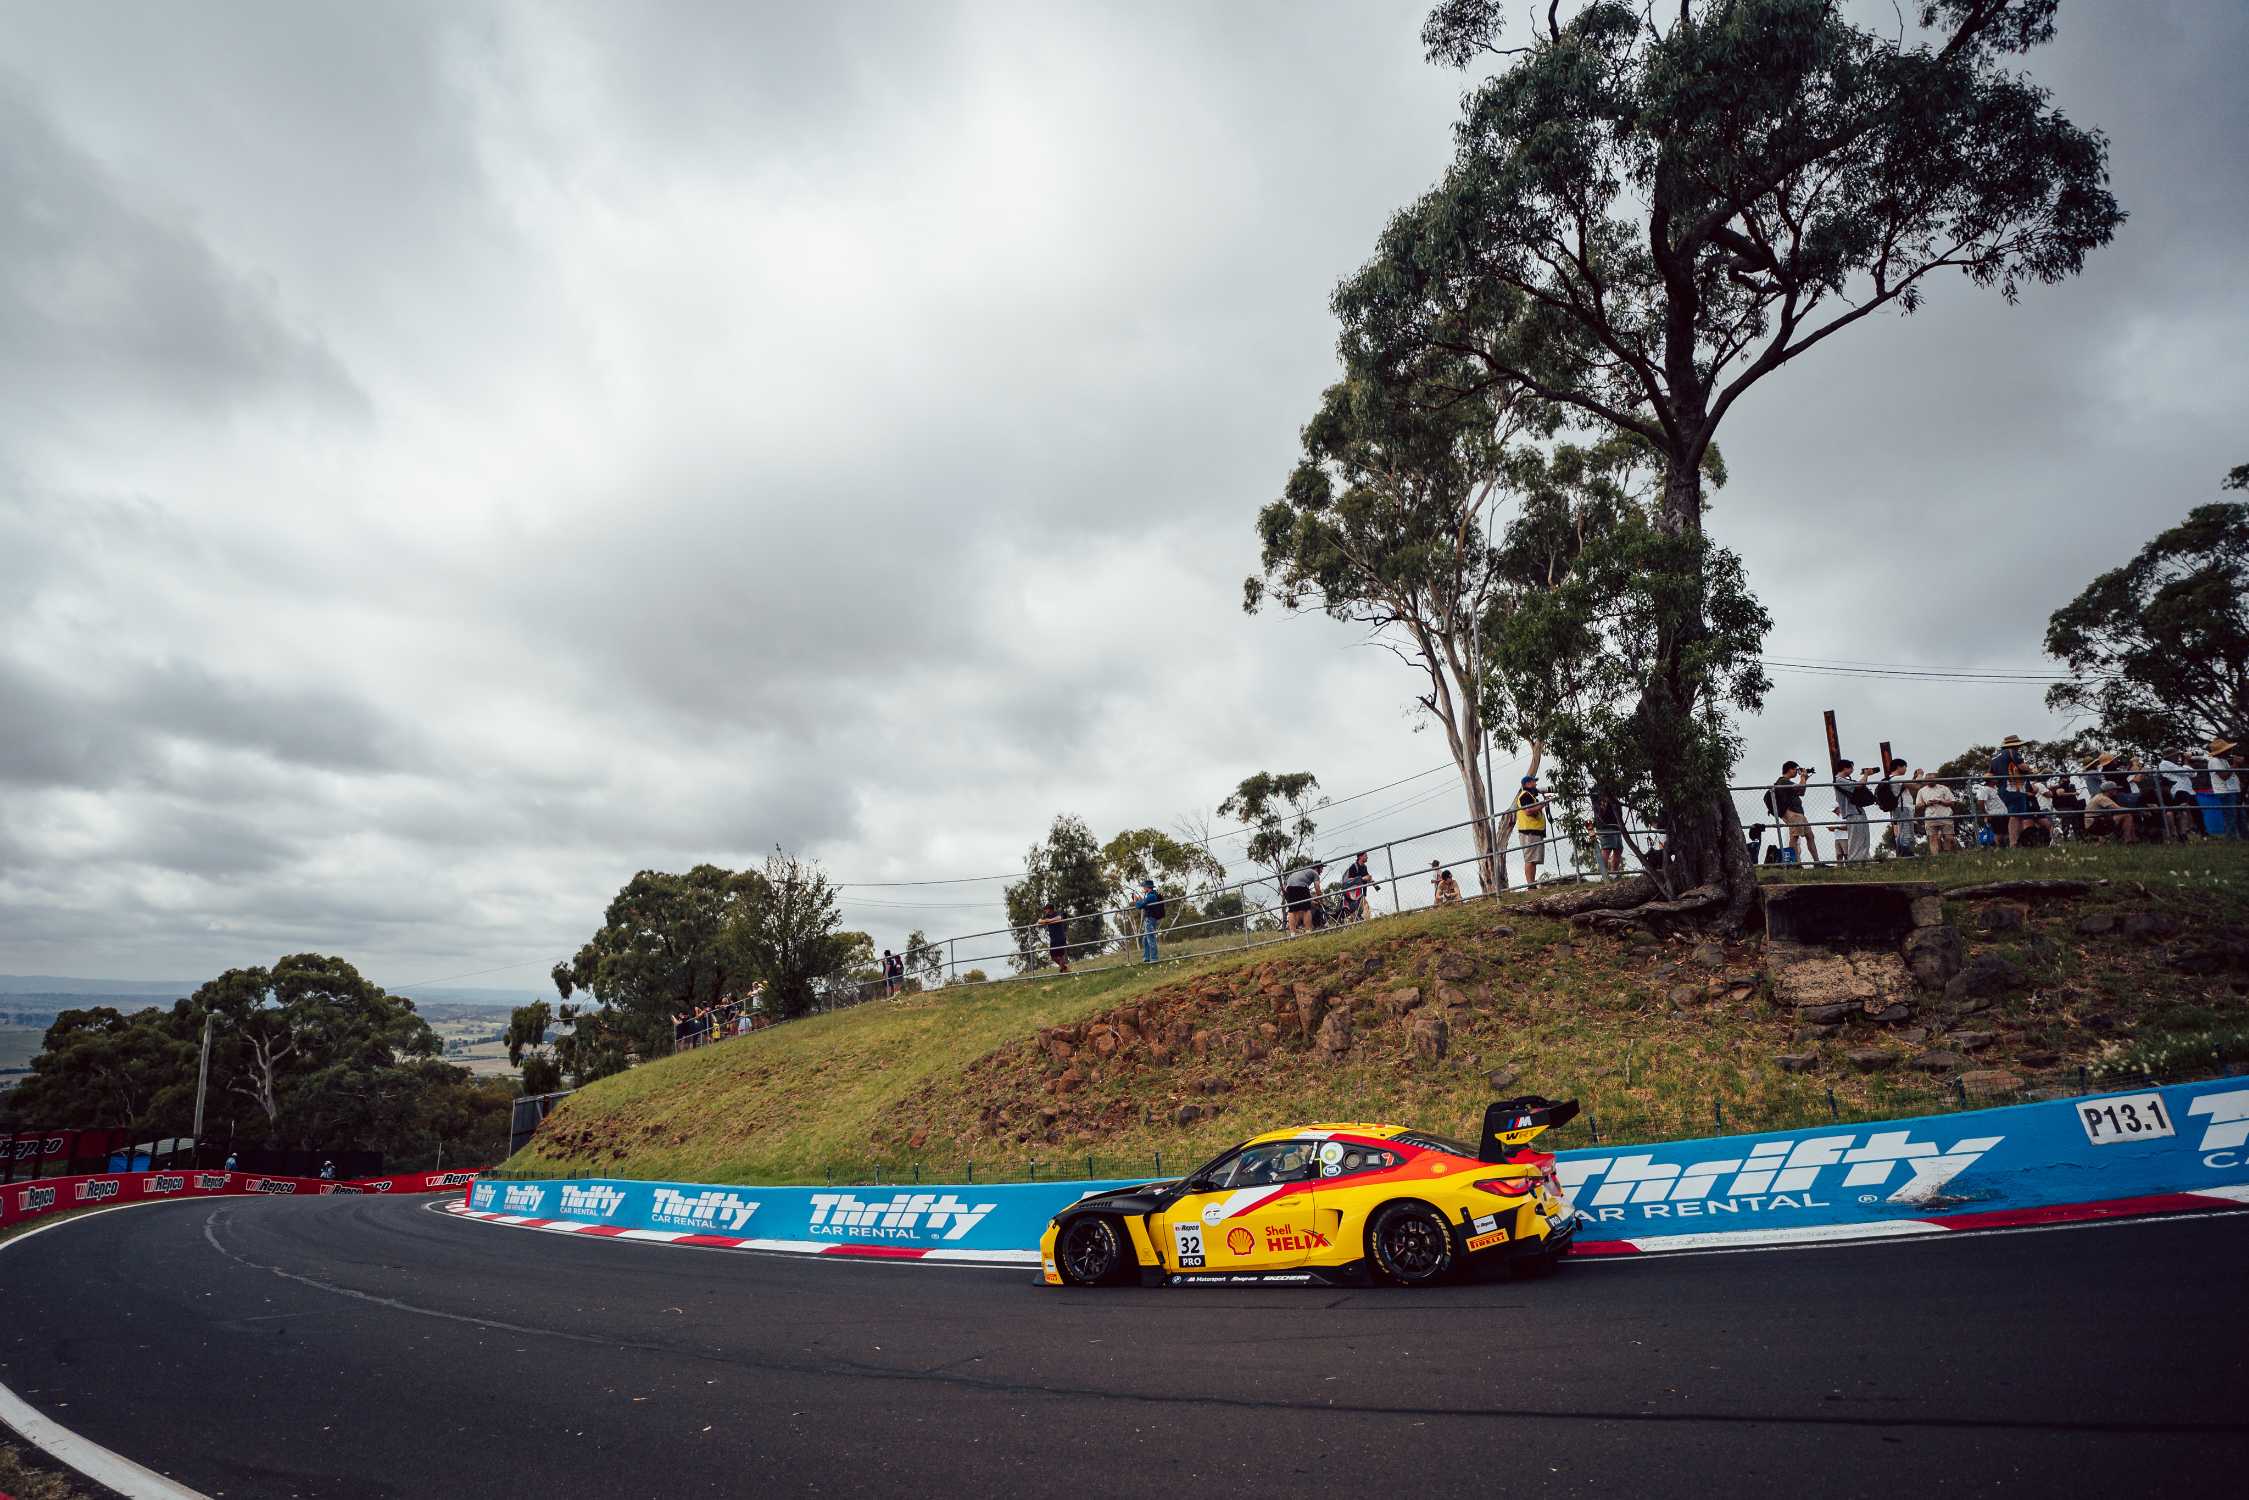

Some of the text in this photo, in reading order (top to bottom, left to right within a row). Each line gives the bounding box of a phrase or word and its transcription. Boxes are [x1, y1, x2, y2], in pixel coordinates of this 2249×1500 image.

[2083, 1100, 2167, 1137] P13.1
[1506, 1129, 1537, 1140] WRT
[1556, 1131, 2006, 1206] Thrifty
[155, 1175, 184, 1193] Repco
[202, 1174, 224, 1191] Repco
[259, 1178, 296, 1194] Repco
[444, 1173, 479, 1185] Repc
[28, 1186, 55, 1211] Repco
[86, 1179, 119, 1200] Repco
[504, 1185, 545, 1211] Thrifty
[560, 1185, 626, 1217] Thrifty
[652, 1188, 760, 1230] Thrifty
[1574, 1208, 1625, 1222] AR
[1643, 1193, 1829, 1217] RENTAL
[573, 1208, 597, 1216] RENTAL
[810, 1194, 997, 1240] Thrifty
[651, 1214, 717, 1229] CAR RENTAL
[1182, 1224, 1199, 1232] Repco
[1265, 1224, 1291, 1236] Shell
[810, 1225, 921, 1239] CAR RENTAL
[1470, 1231, 1505, 1249] PIRELLI
[1181, 1236, 1200, 1254] 32
[1266, 1233, 1330, 1252] HELIX
[1183, 1257, 1202, 1266] PRO
